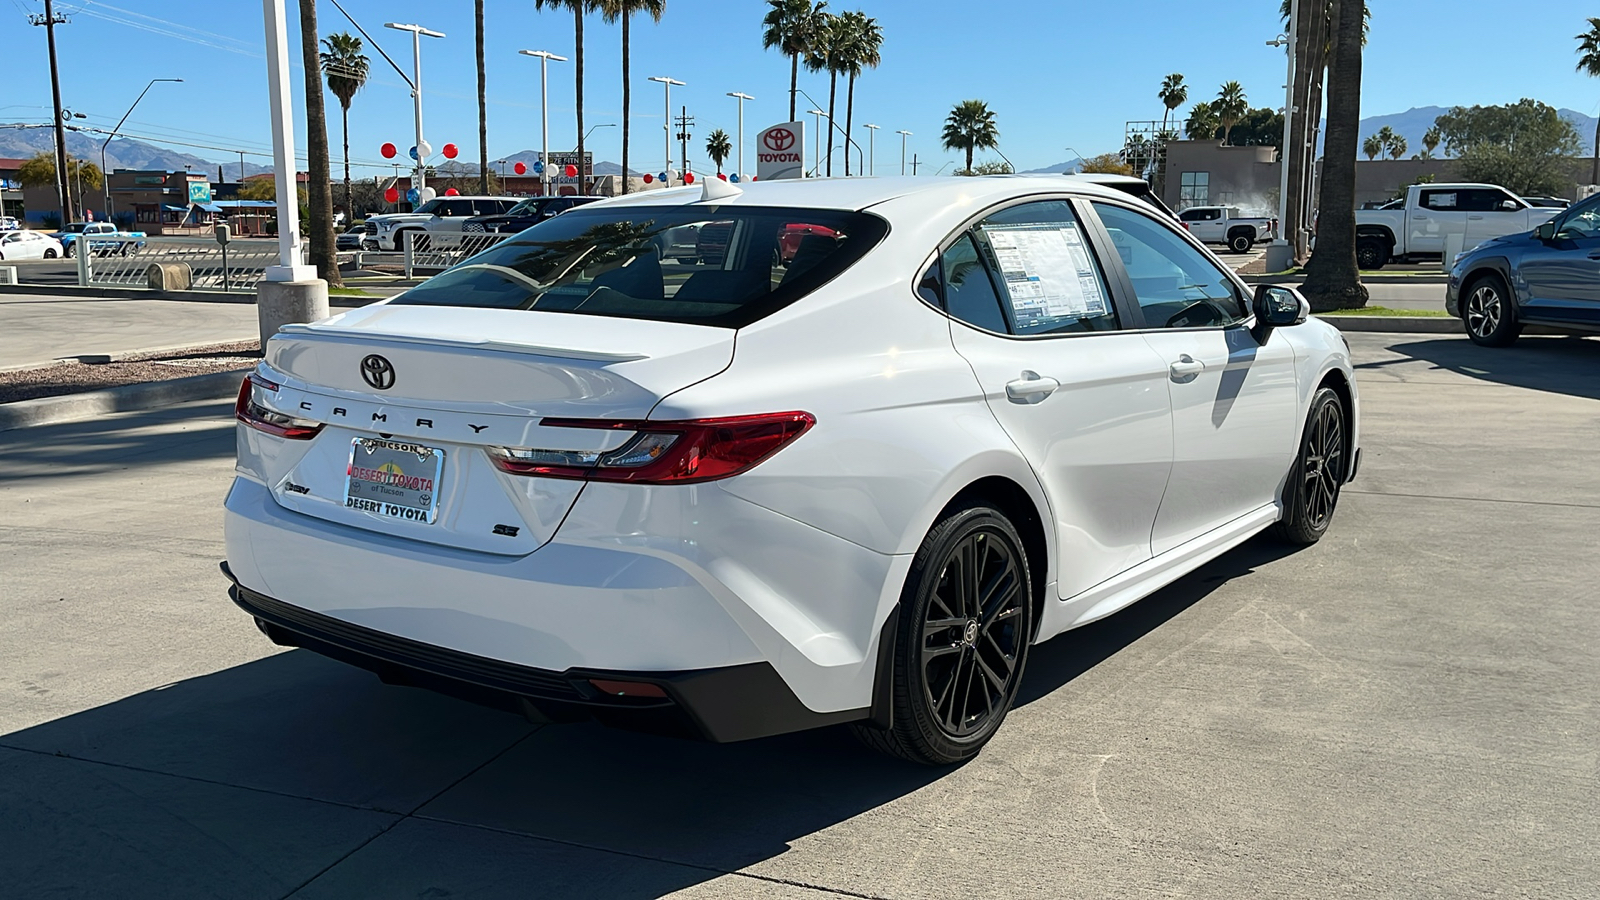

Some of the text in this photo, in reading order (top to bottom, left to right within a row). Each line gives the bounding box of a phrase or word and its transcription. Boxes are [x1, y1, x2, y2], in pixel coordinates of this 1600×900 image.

[758, 153, 801, 163] TOYOTA
[299, 401, 490, 434] CAMRY
[375, 440, 418, 453] TUCSON
[352, 466, 433, 492] DESERT TOYOTA
[380, 486, 405, 497] Tucson
[347, 497, 428, 522] DESERT TOYOTA
[492, 523, 520, 537] SE
